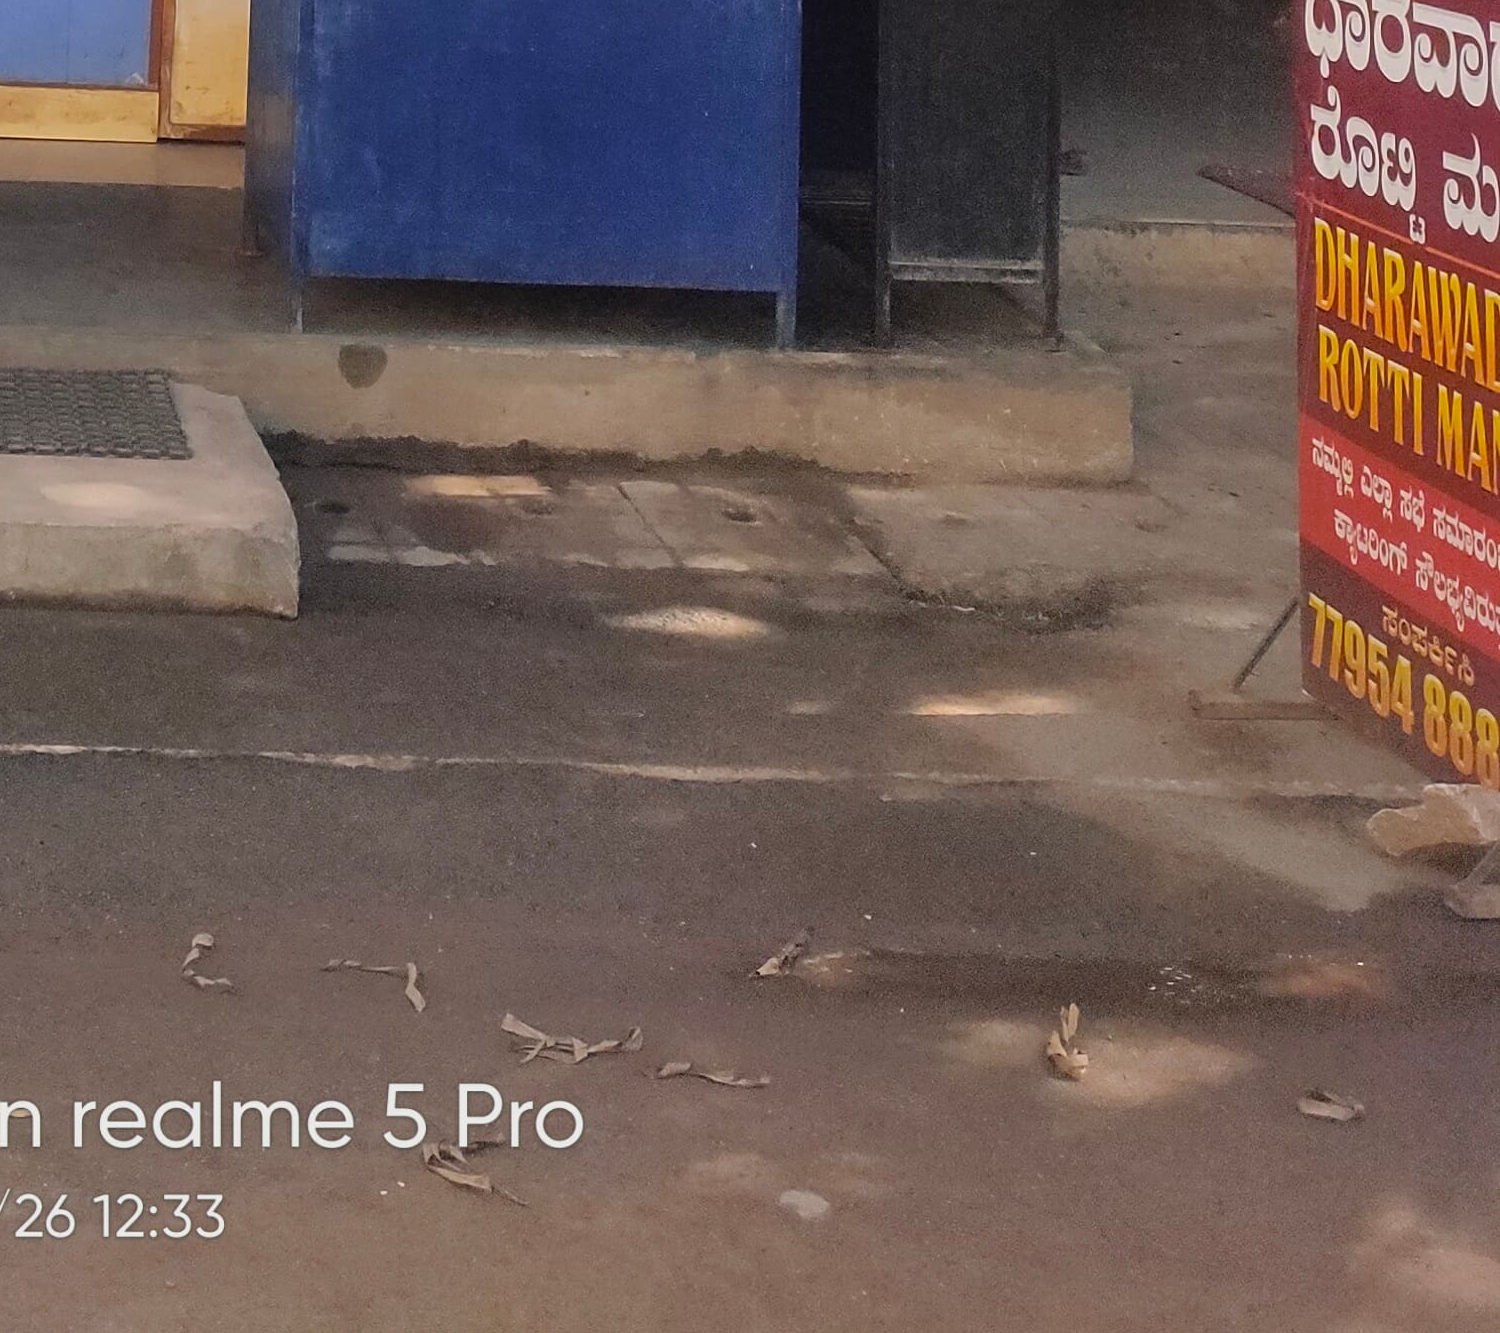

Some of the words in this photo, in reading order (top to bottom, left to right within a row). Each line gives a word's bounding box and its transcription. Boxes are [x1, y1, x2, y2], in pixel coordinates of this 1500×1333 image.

[1442, 132, 1500, 243] ಮ
[1314, 217, 1500, 393] DHARAWAD
[1318, 324, 1424, 456] ROTTI
[1360, 465, 1393, 523] ಎಲ್ಲಾ
[1432, 504, 1500, 570] ಸಮಾರಂ
[1415, 551, 1500, 651] ಸೌಲಭ್ಯವಿರು
[1309, 592, 1415, 735] 77954
[1423, 673, 1500, 791] 888
